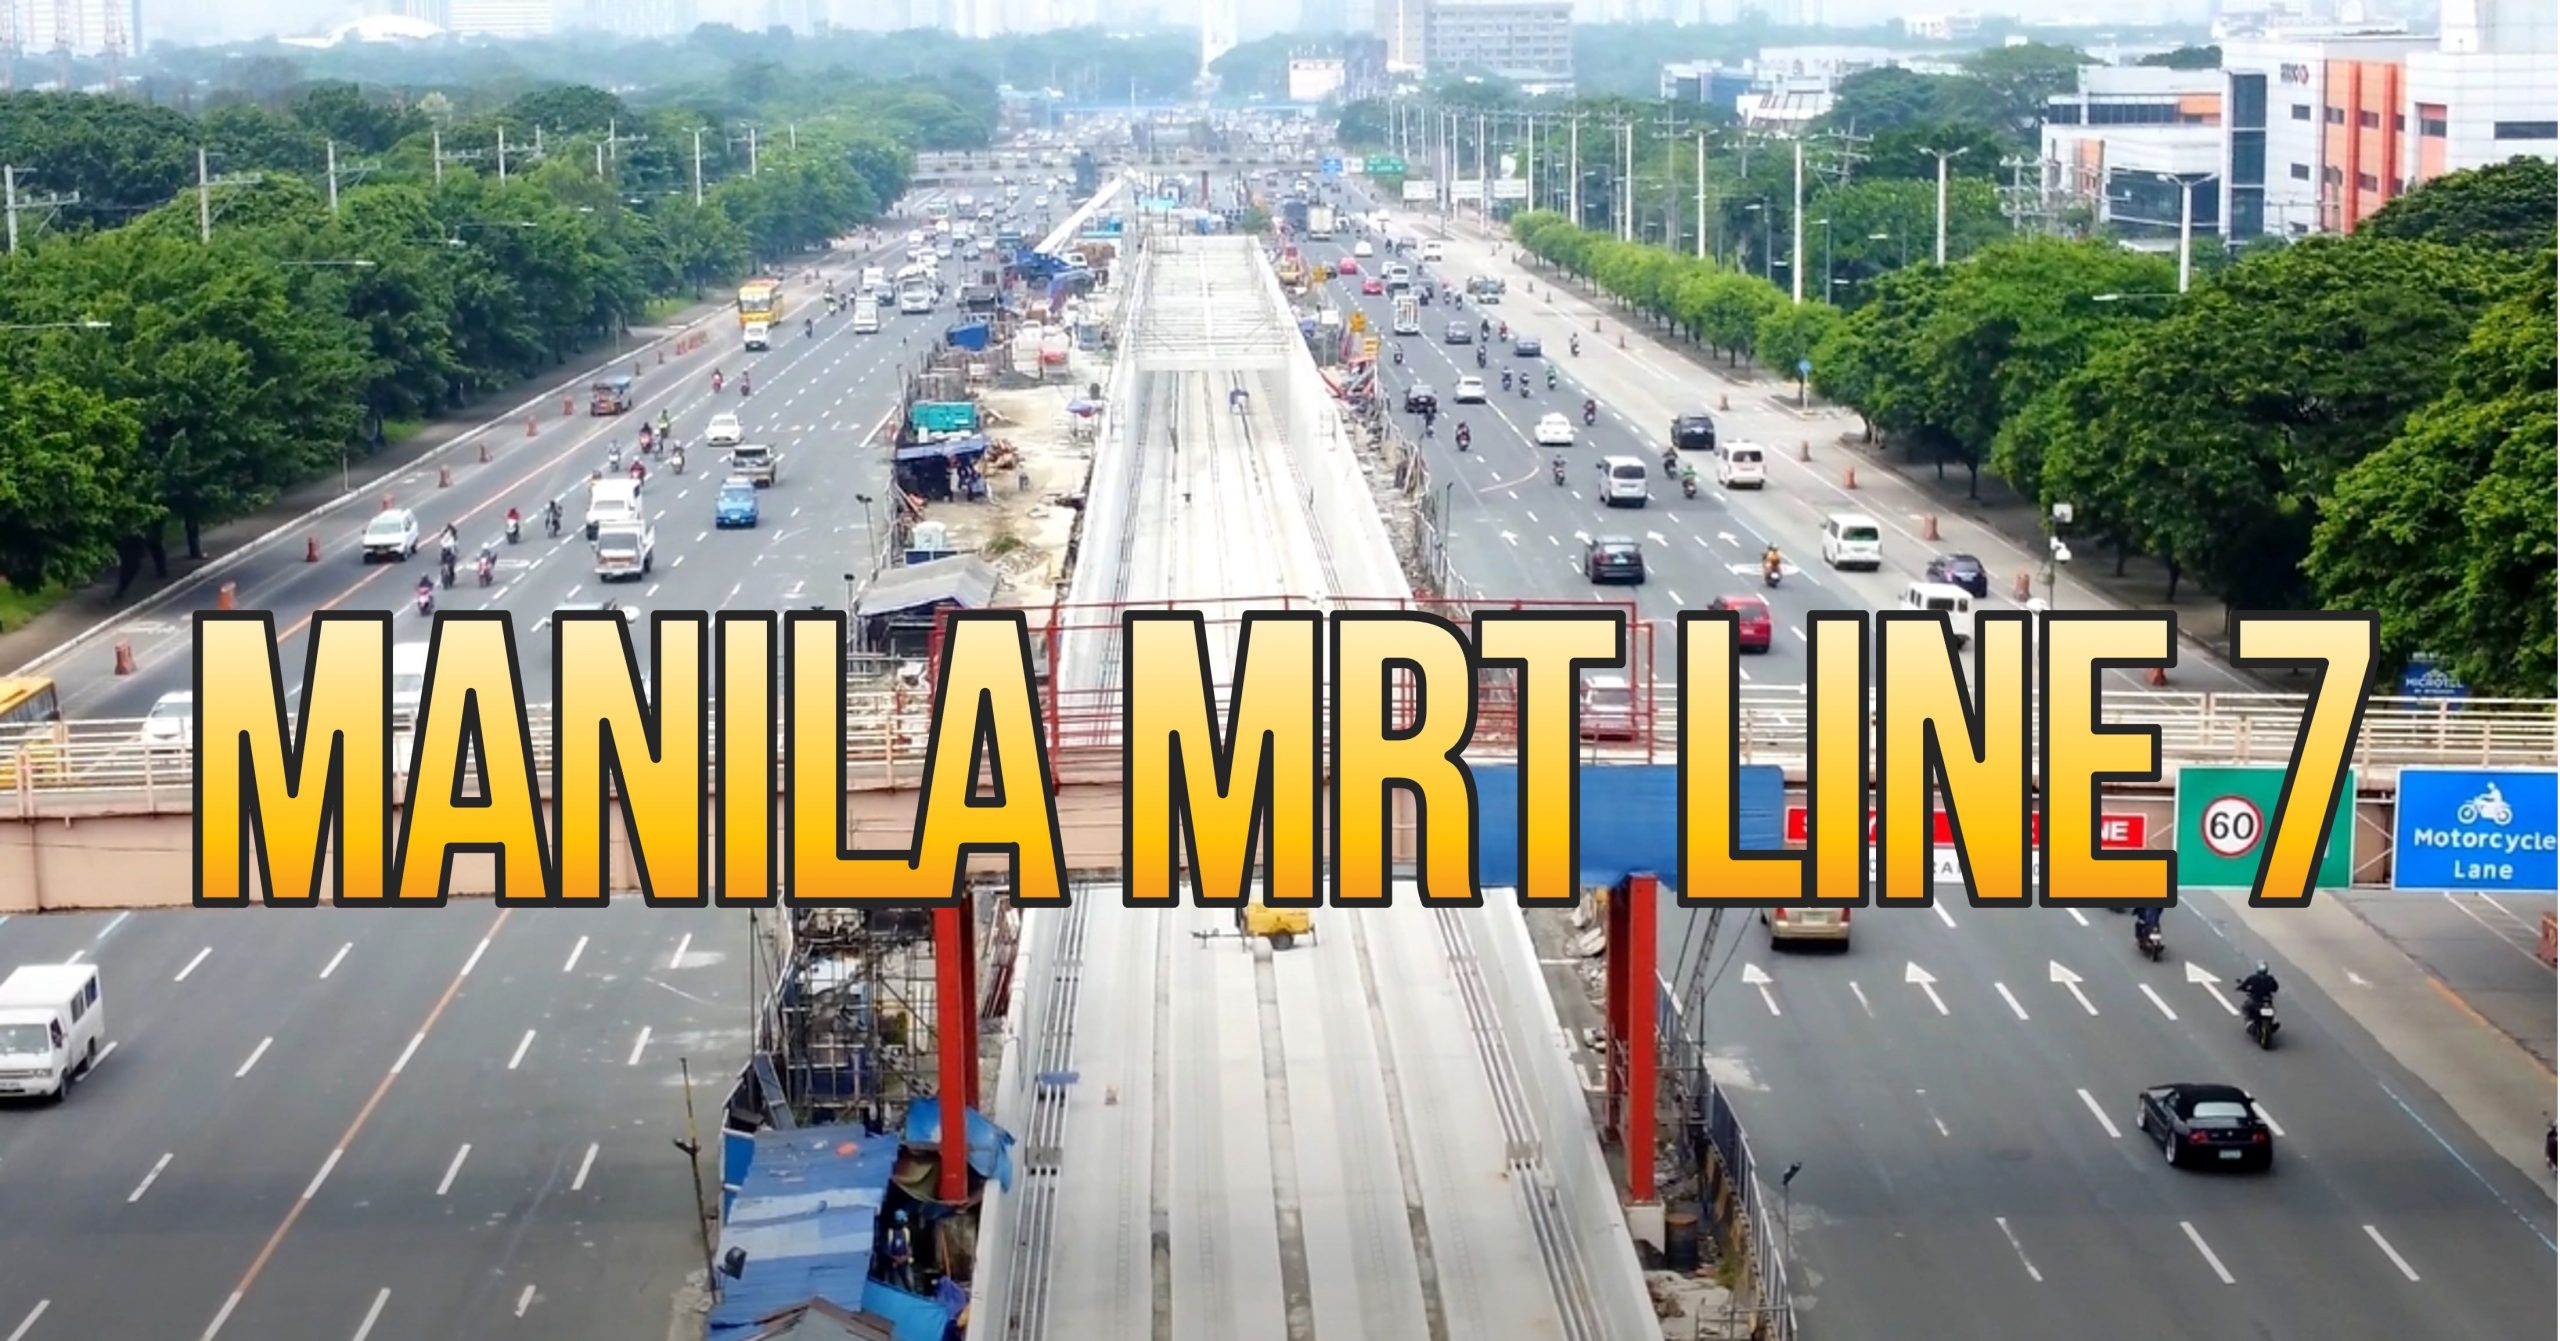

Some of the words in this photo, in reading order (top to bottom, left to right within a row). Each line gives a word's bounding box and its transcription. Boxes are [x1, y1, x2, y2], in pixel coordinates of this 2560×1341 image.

[2209, 811, 2254, 841] 60
[2413, 827, 2558, 854] Motorcycle
[2453, 860, 2514, 880] Lane
